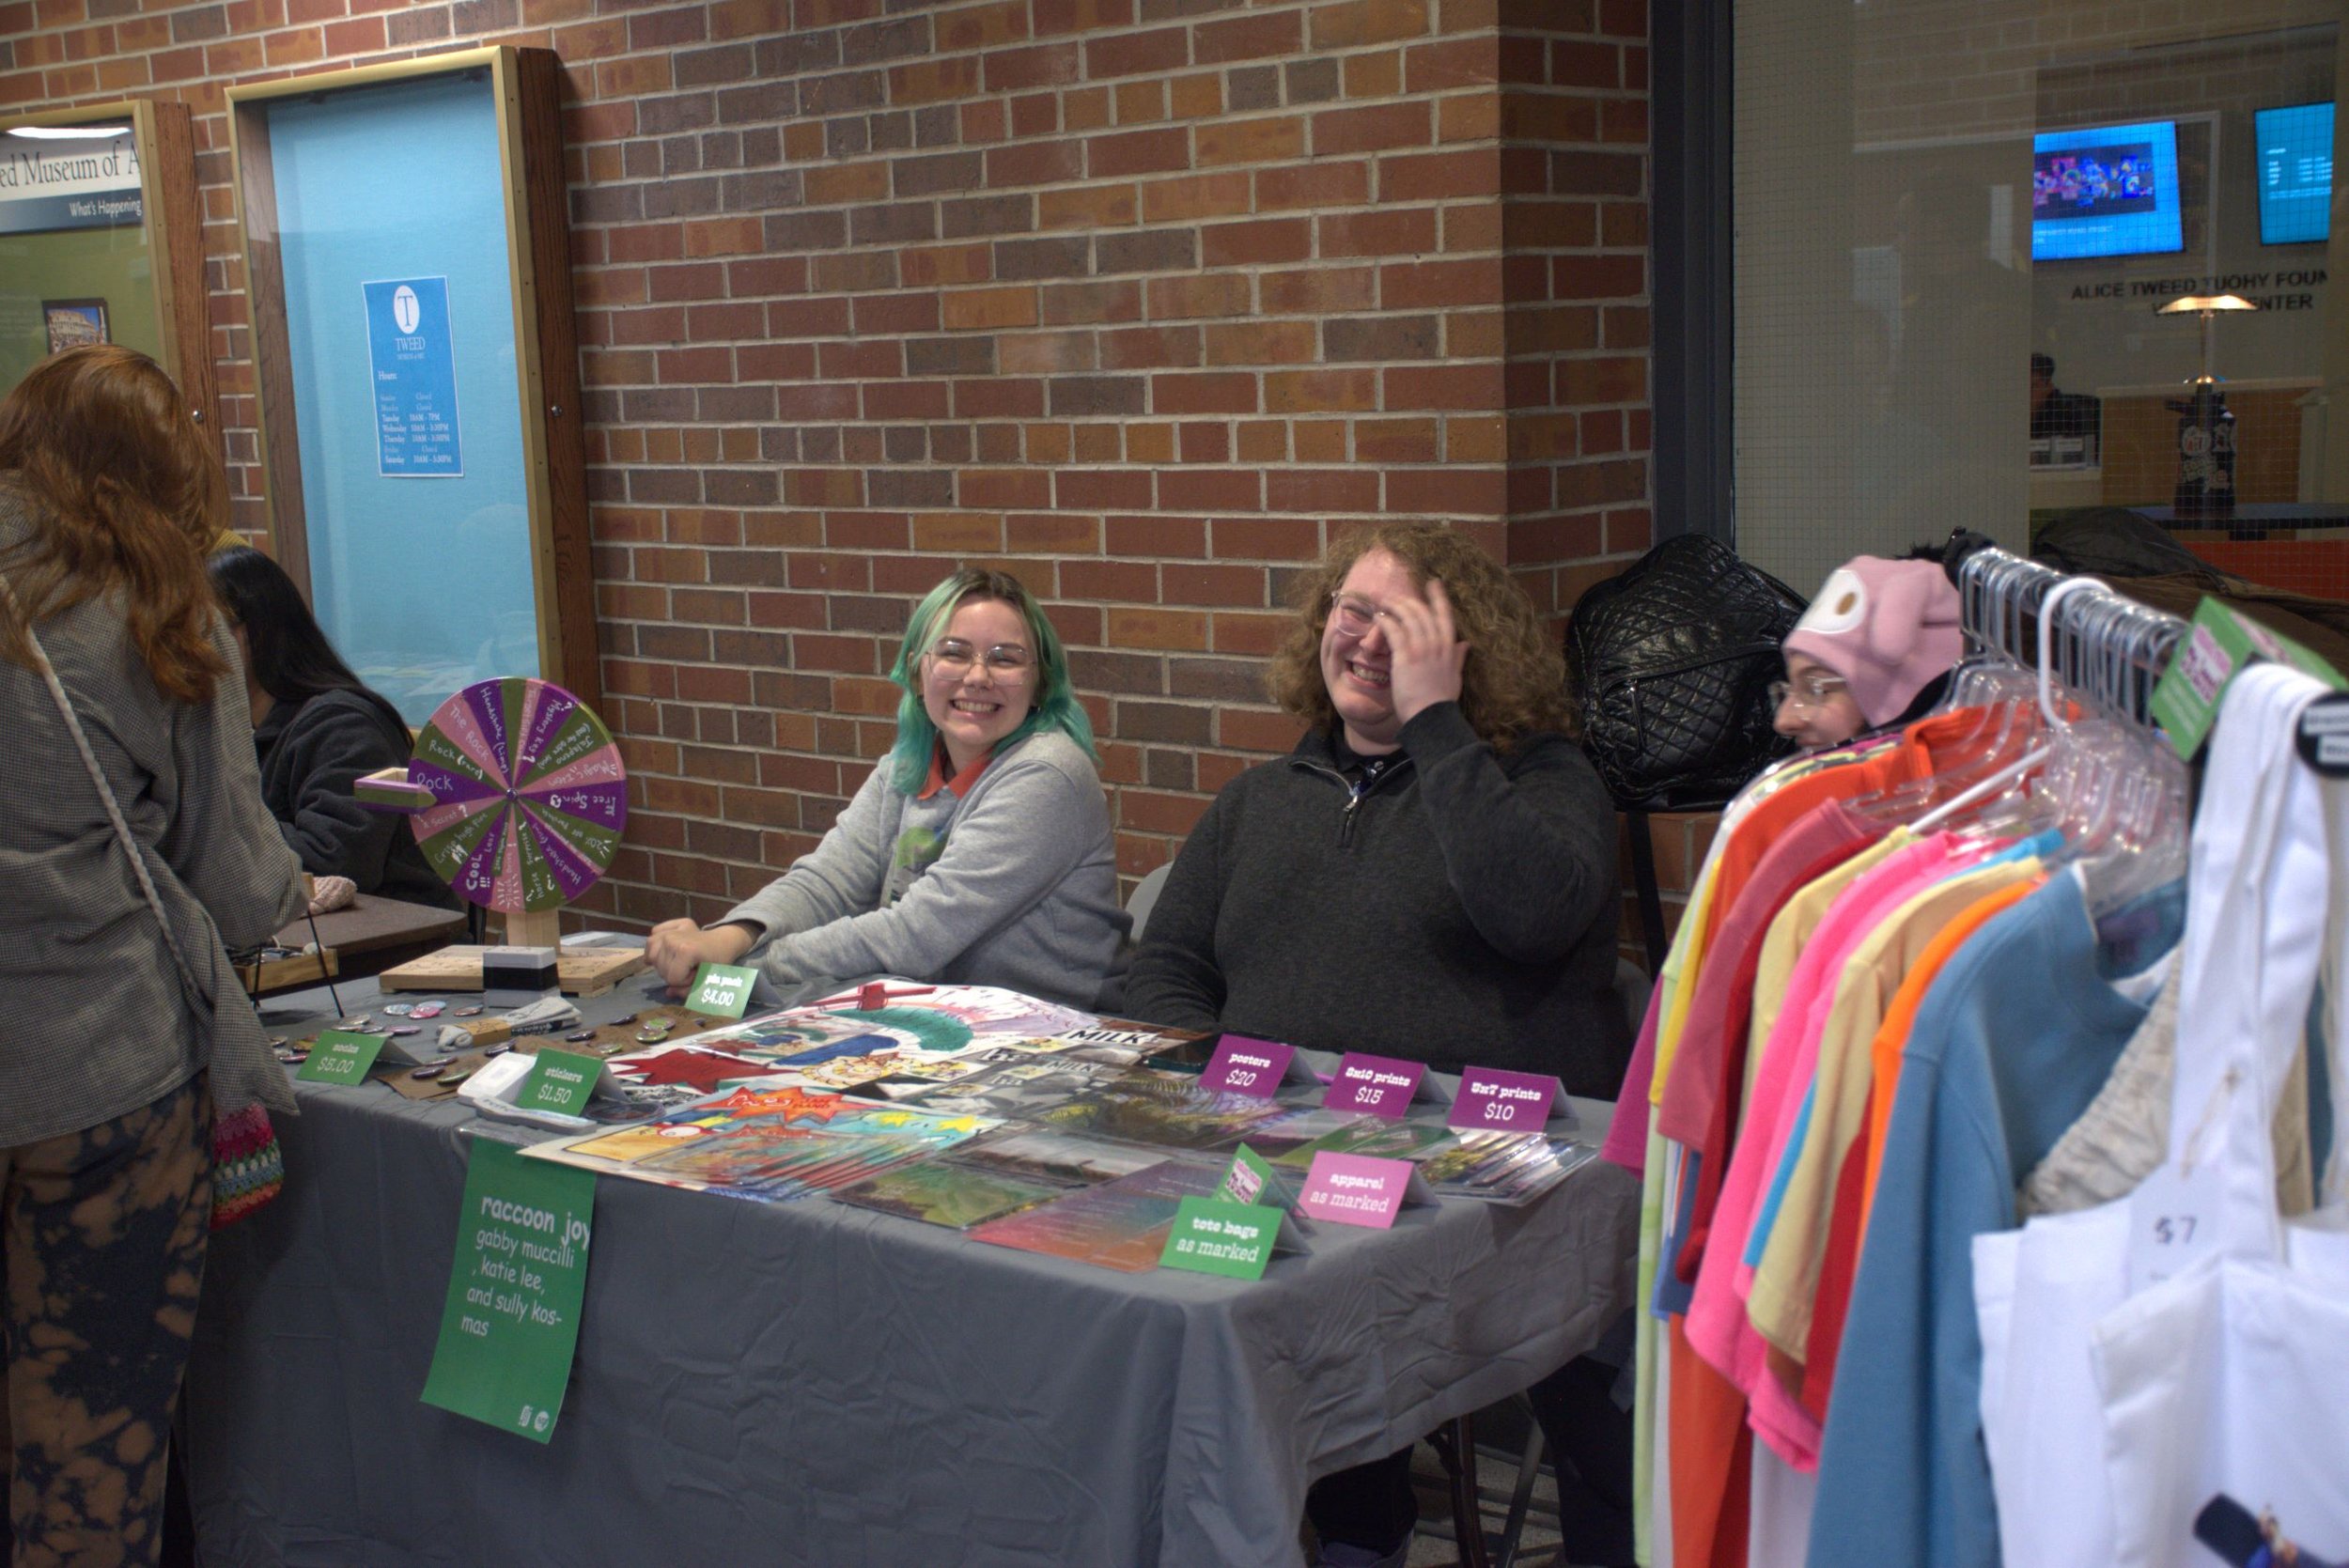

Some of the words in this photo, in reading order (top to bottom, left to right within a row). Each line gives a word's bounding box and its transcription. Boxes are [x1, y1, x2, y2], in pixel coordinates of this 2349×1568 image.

[22, 150, 99, 185] Museum
[102, 140, 121, 177] of
[70, 201, 97, 217] What's
[98, 198, 142, 216] Happening
[2072, 283, 2123, 300] ALICE
[2132, 279, 2197, 296] TWEED
[395, 336, 426, 352] TWEED
[480, 687, 503, 740] Handshake
[536, 699, 562, 734] Mystery
[428, 739, 456, 760] Rock
[466, 731, 489, 762] Rock
[528, 737, 544, 753] Key
[576, 760, 611, 779] Magic
[563, 791, 588, 810] Spin
[593, 795, 616, 816] Free
[546, 846, 582, 885] Handshake
[701, 987, 735, 1007] $4.00
[317, 1056, 355, 1074] $5.00
[1229, 1051, 1271, 1069] posters
[545, 1066, 583, 1083] stickers
[1224, 1069, 1258, 1088] $20
[1374, 1072, 1411, 1089] prints
[537, 1082, 572, 1105] $1.50
[1354, 1085, 1386, 1106] $15
[1498, 1086, 1542, 1102] prints
[1484, 1102, 1516, 1122] $10
[1329, 1171, 1386, 1190] apparel
[1309, 1189, 1329, 1205] as
[1330, 1192, 1390, 1214] marked
[480, 1195, 554, 1234] raccoon
[560, 1210, 590, 1251] joy
[1192, 1216, 1223, 1235] tote
[1223, 1217, 1259, 1240] bags
[2155, 1214, 2198, 1246] $7
[475, 1228, 518, 1255] gabby
[521, 1237, 575, 1268] muccilli
[1176, 1237, 1193, 1253] as
[1197, 1240, 1258, 1265] marked
[480, 1256, 517, 1283] katie
[520, 1265, 546, 1296] lee,
[466, 1286, 492, 1307] and
[495, 1292, 529, 1323] sully
[531, 1300, 563, 1326] kos-
[460, 1313, 490, 1337] mas
